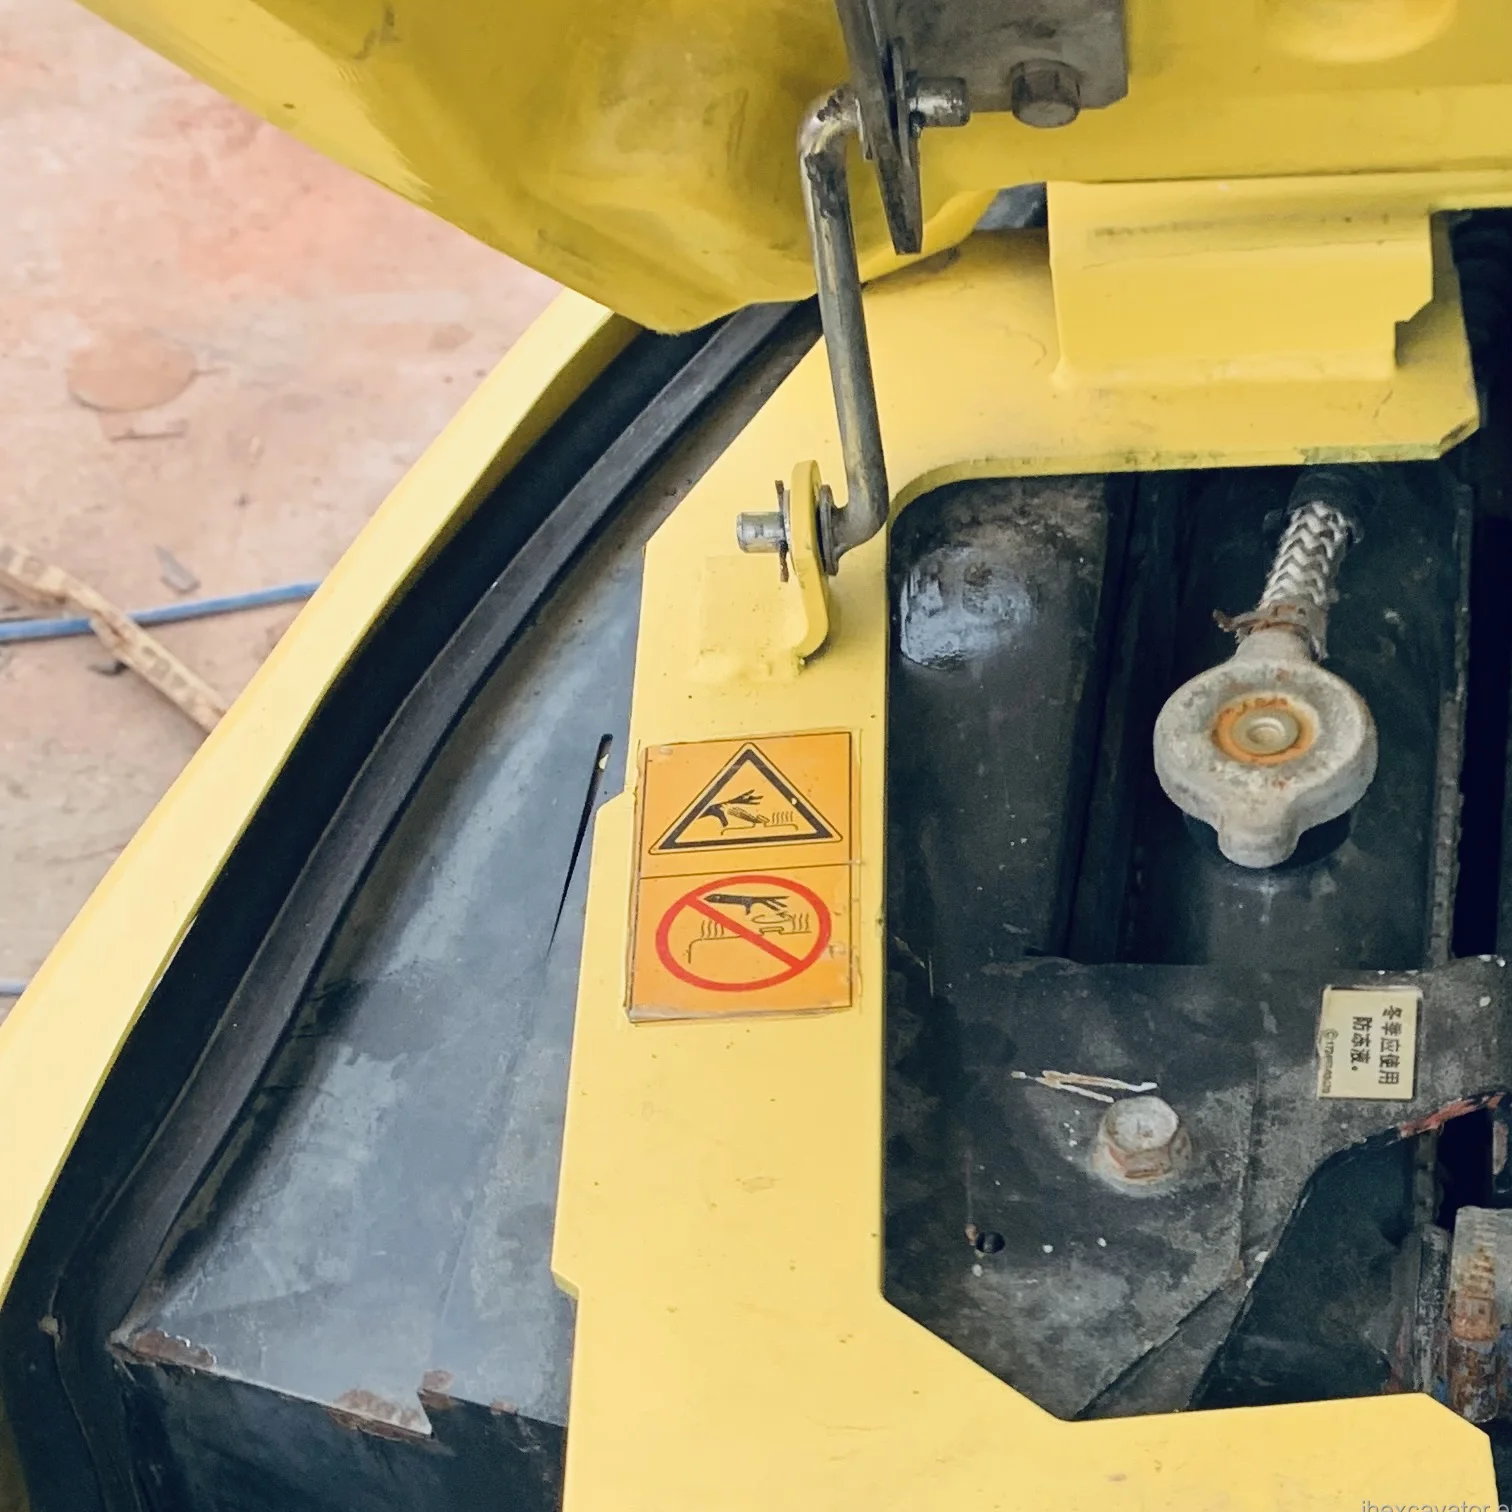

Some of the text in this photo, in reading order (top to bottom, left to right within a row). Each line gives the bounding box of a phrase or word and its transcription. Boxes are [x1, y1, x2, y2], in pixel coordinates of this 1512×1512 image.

[1378, 1005, 1403, 1085] 冬季应使用
